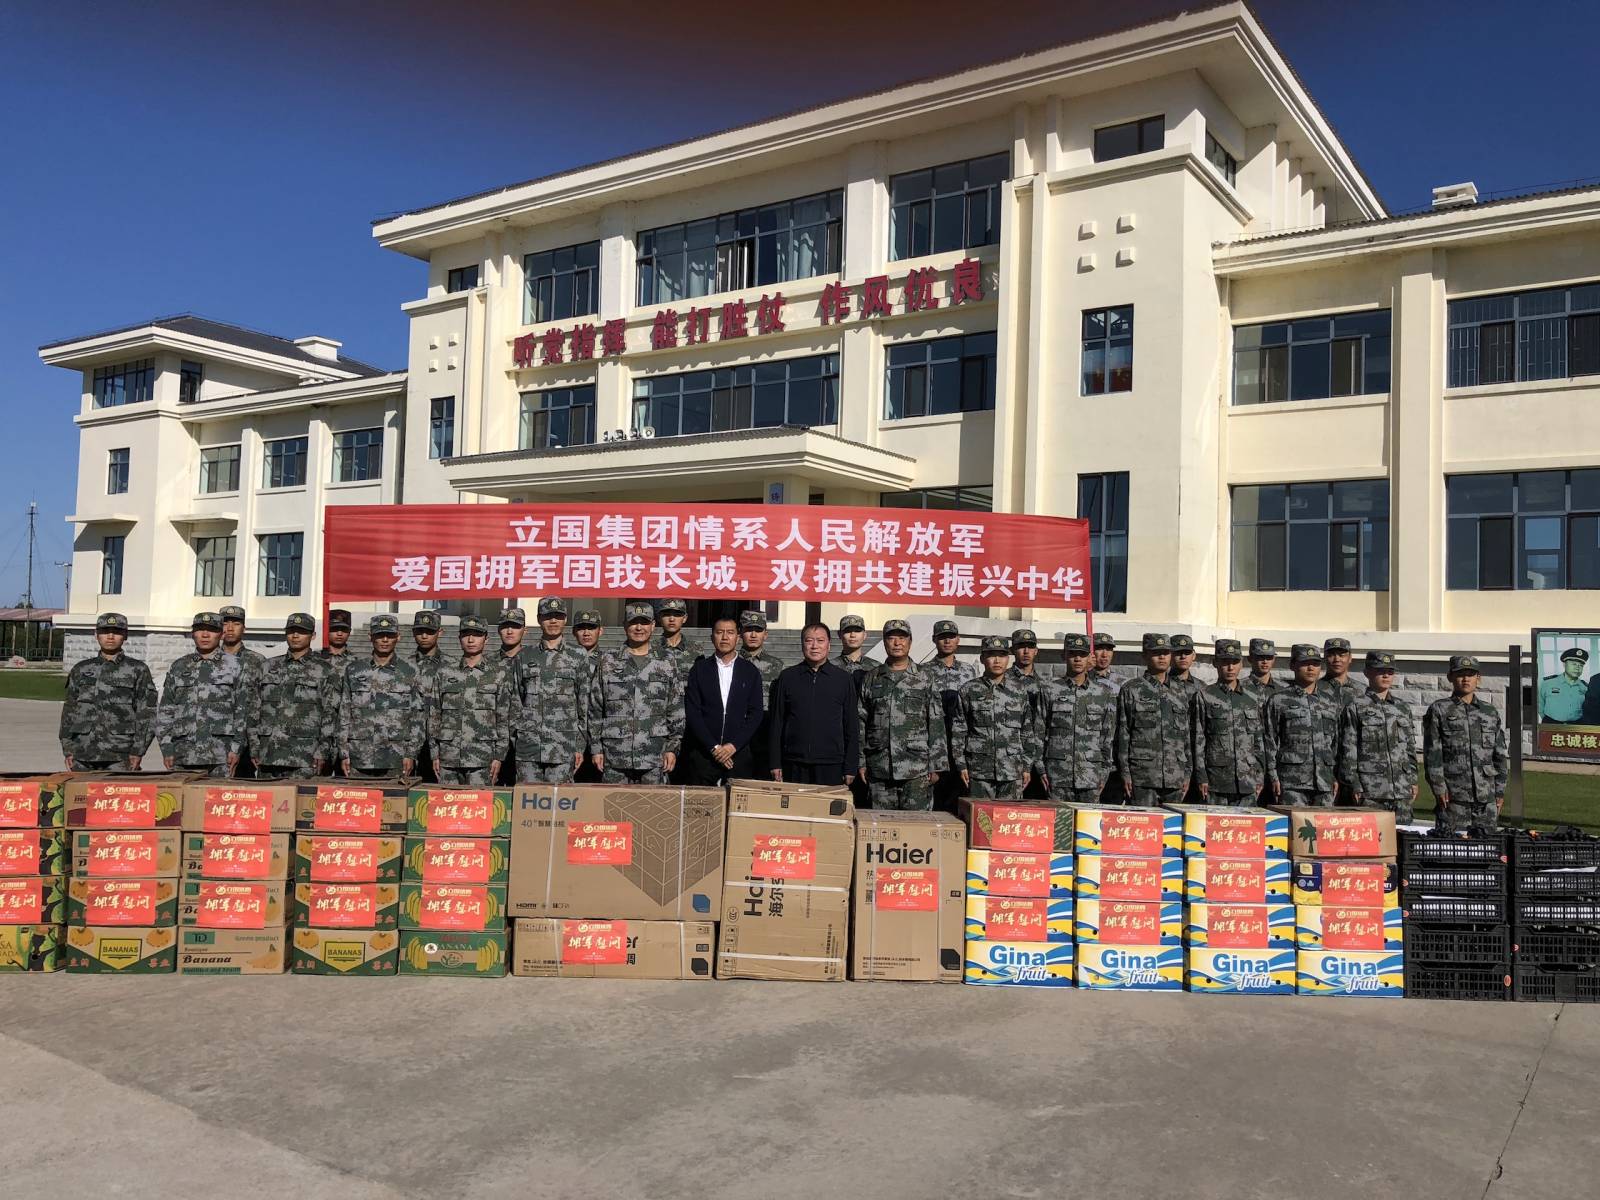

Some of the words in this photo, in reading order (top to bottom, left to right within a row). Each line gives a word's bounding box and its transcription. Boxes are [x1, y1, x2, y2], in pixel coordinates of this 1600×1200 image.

[513, 319, 626, 369] 听党指挥
[652, 292, 786, 351] 能打胜仗
[820, 258, 985, 325] 作风优良
[506, 514, 985, 559] 立国集团情系人民解放军
[1551, 733, 1600, 748] 忠诚核
[522, 792, 579, 811] Haer
[866, 843, 934, 865] Haier
[183, 955, 231, 964] Banana
[990, 946, 1046, 966] Gina
[1101, 950, 1157, 970] Gina
[1213, 954, 1269, 973] Gina
[1014, 966, 1046, 983] fruit
[1321, 956, 1377, 976] Gina
[1127, 970, 1159, 985] fruit
[1238, 974, 1270, 989] fruit
[1347, 977, 1379, 992] fruit
